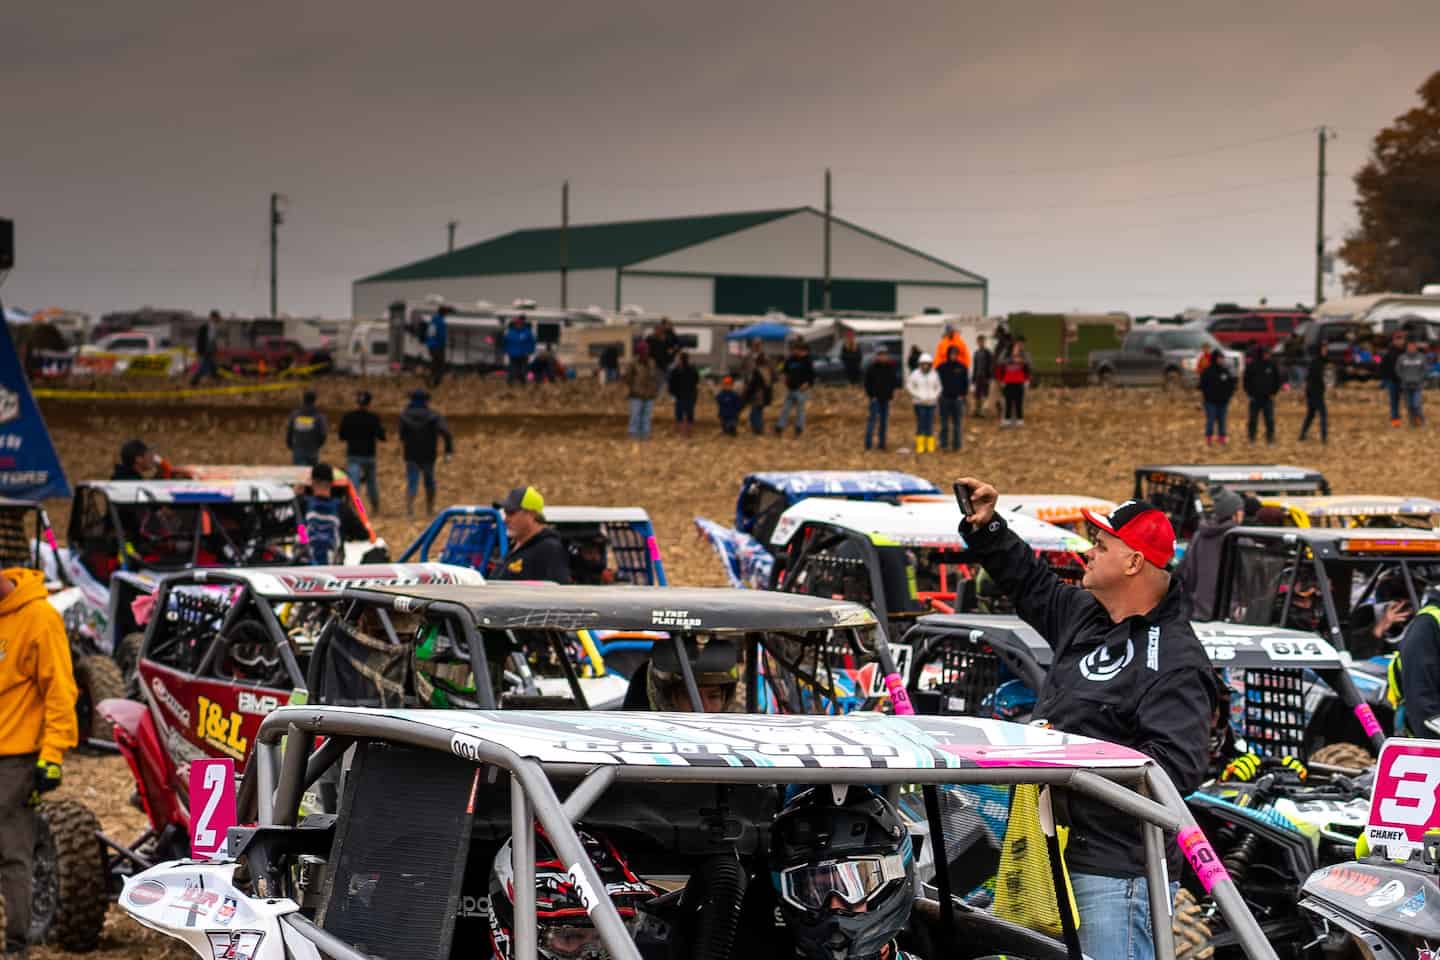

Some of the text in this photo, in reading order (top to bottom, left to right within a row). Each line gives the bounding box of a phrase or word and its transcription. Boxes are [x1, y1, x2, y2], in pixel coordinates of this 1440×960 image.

[1271, 641, 1322, 656] 614
[197, 696, 248, 753] J&L
[193, 764, 227, 847] 2
[1370, 829, 1404, 841] CHANEY
